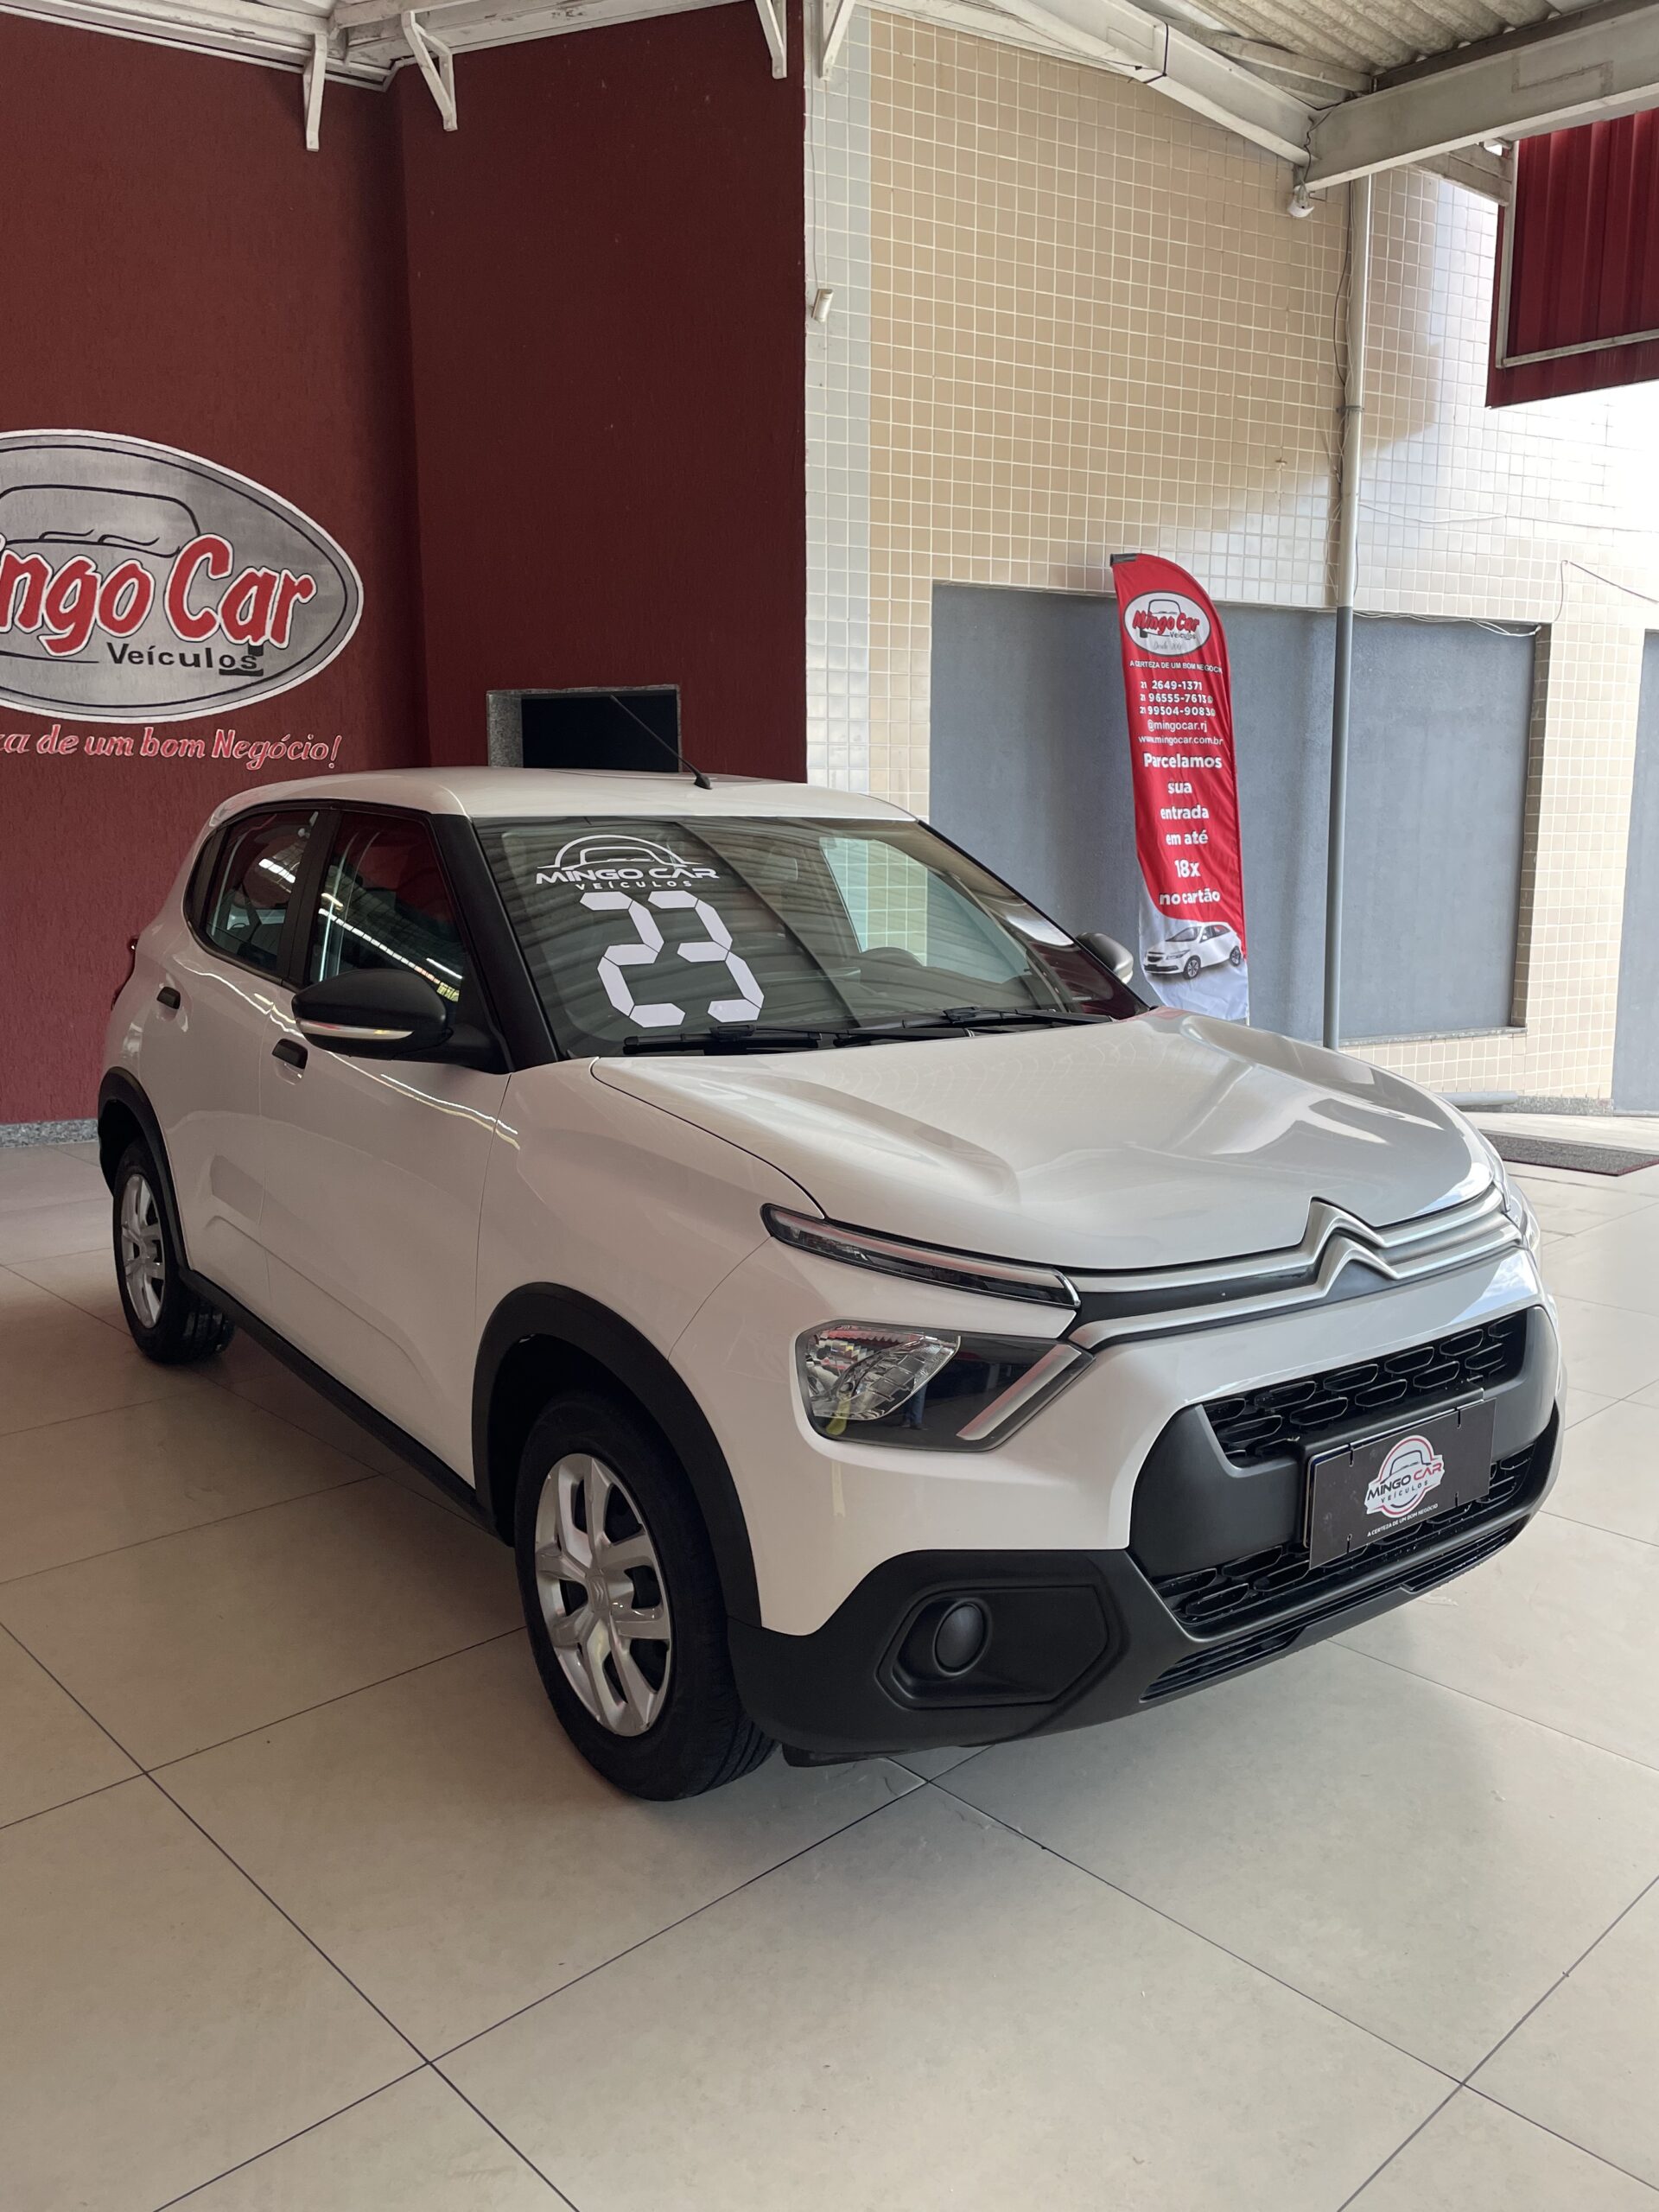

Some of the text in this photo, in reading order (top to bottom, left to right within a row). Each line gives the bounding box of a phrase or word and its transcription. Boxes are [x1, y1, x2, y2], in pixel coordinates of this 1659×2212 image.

[0, 534, 316, 657] ngo Car
[1132, 610, 1200, 635] Mingo Car
[106, 642, 258, 670] Veículos
[1135, 660, 1160, 669] CERTEZA
[1151, 679, 1203, 690] 2649-1371
[1148, 692, 1207, 703] 96555-7613
[1147, 719, 1208, 733] @mingocar.rj
[36, 724, 78, 755] de
[85, 736, 134, 757] um
[140, 728, 206, 759] bom
[211, 729, 342, 770] Negócio!
[1143, 752, 1223, 769] Parcelamos
[1167, 782, 1192, 794] sua
[1160, 804, 1210, 820] entrada
[1166, 830, 1209, 845] em até
[536, 868, 720, 885] MINGO CAR
[1174, 859, 1201, 878] 18x
[1160, 887, 1221, 906] no cartão
[580, 890, 765, 1028] 23
[1367, 1462, 1442, 1501] MINGO CAR
[1371, 1522, 1392, 1535] CERTEZA
[1407, 1512, 1417, 1521] BOM
